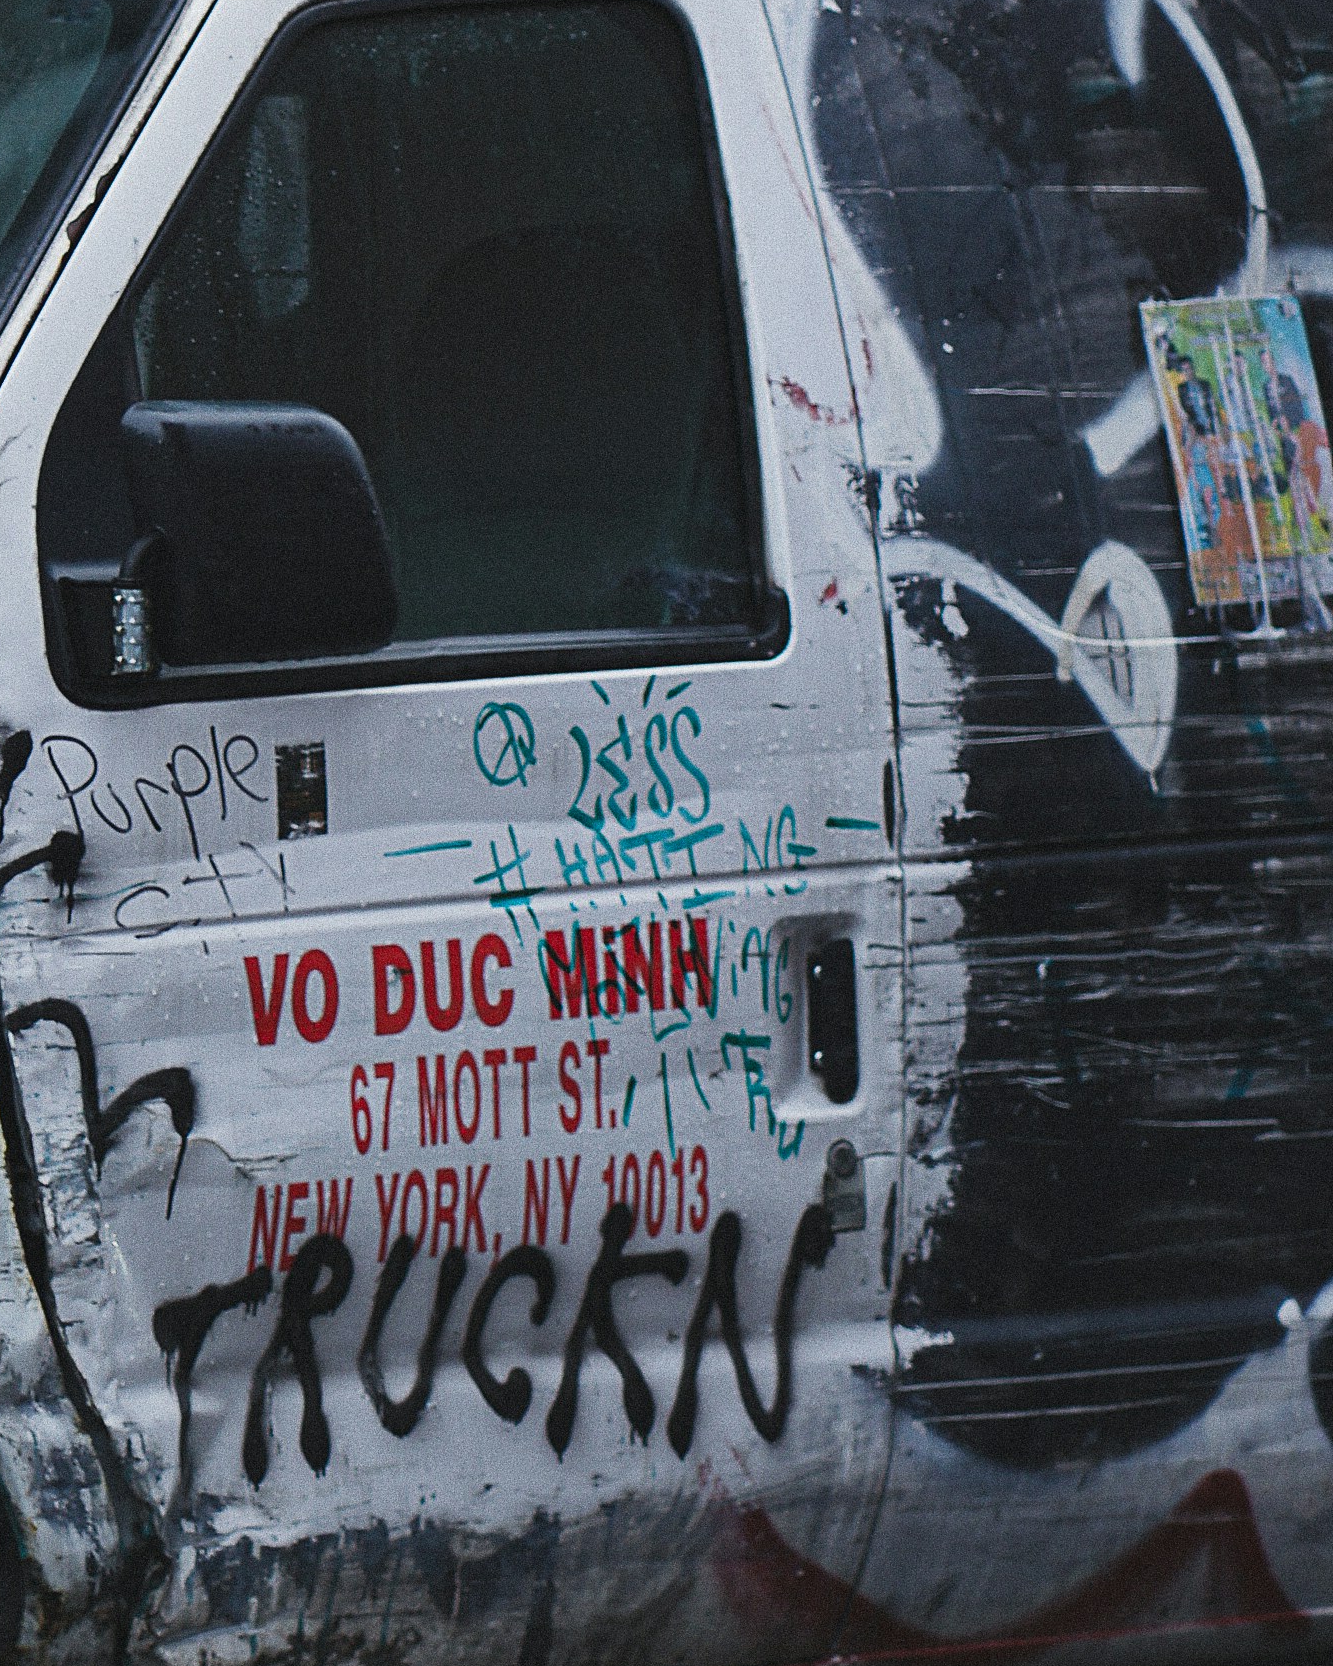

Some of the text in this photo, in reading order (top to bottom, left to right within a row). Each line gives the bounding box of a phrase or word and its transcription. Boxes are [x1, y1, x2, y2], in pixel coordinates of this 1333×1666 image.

[40, 725, 270, 861] Purple
[243, 949, 339, 1046] VO
[371, 933, 516, 1036] DUC
[350, 1038, 619, 1155] 67 MOTT ST.
[246, 1177, 354, 1275] NEW
[523, 1154, 581, 1248] NY
[601, 1144, 710, 1238] 10013
